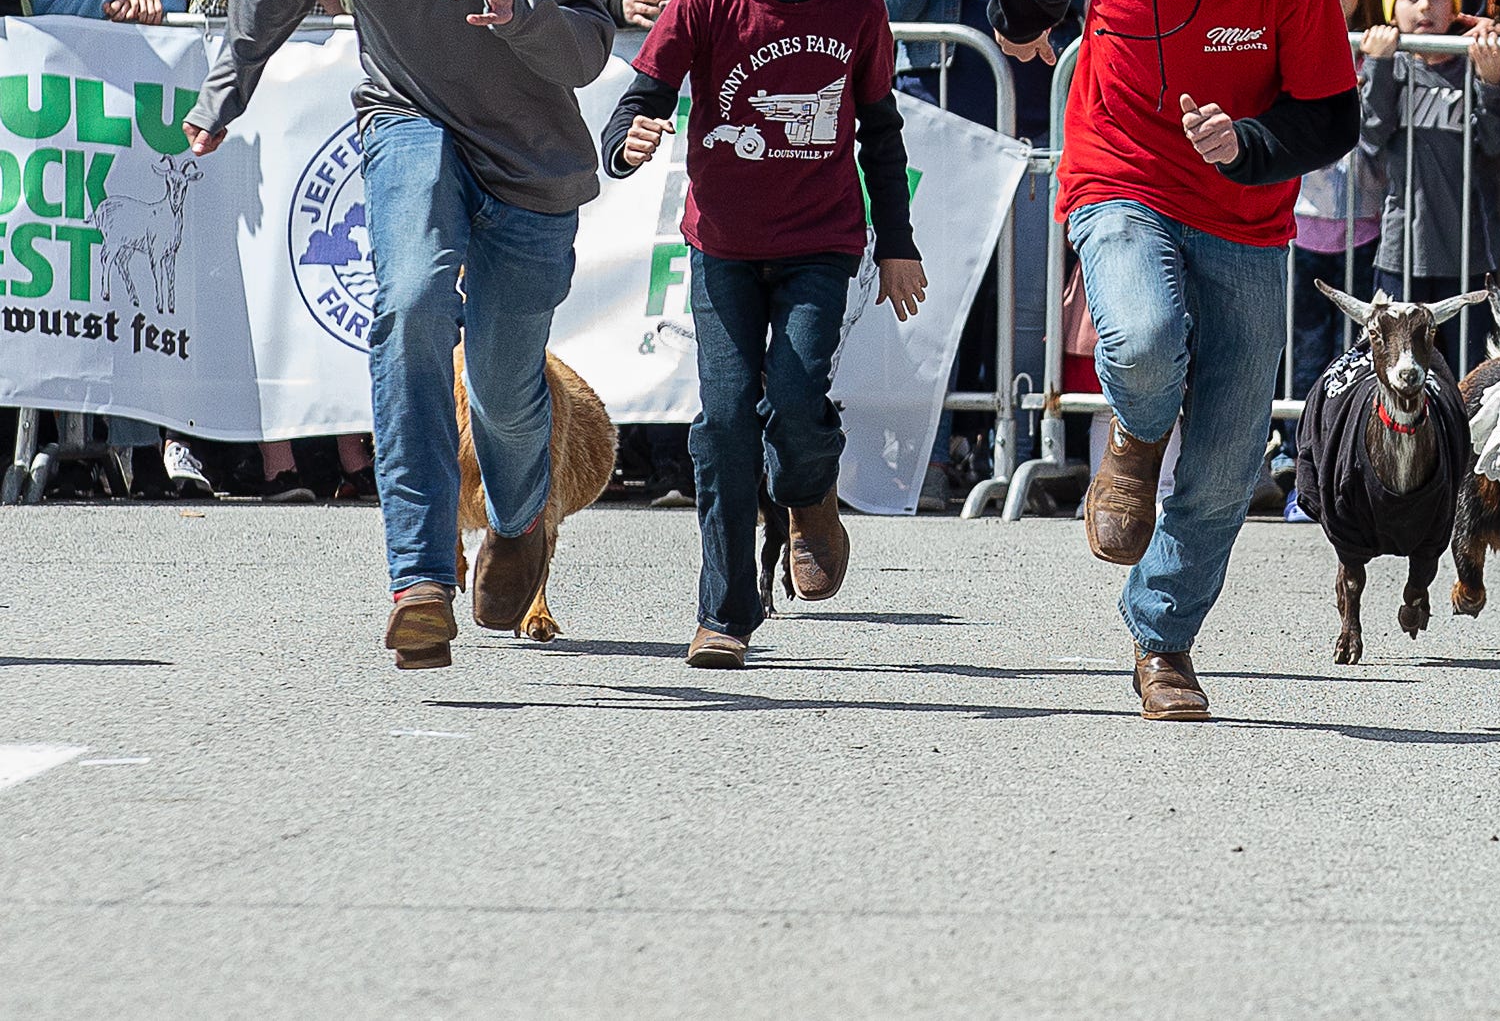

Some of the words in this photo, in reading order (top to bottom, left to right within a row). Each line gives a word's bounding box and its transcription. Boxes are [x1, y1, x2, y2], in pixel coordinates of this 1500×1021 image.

[1236, 42, 1268, 51] GOATS
[718, 63, 749, 120] SUNNY
[750, 36, 802, 71] ACRES
[805, 34, 853, 64] FARM
[0, 221, 104, 303] ST
[1, 306, 119, 342] wurst
[131, 312, 190, 361] fest
[317, 286, 372, 342] FAR
